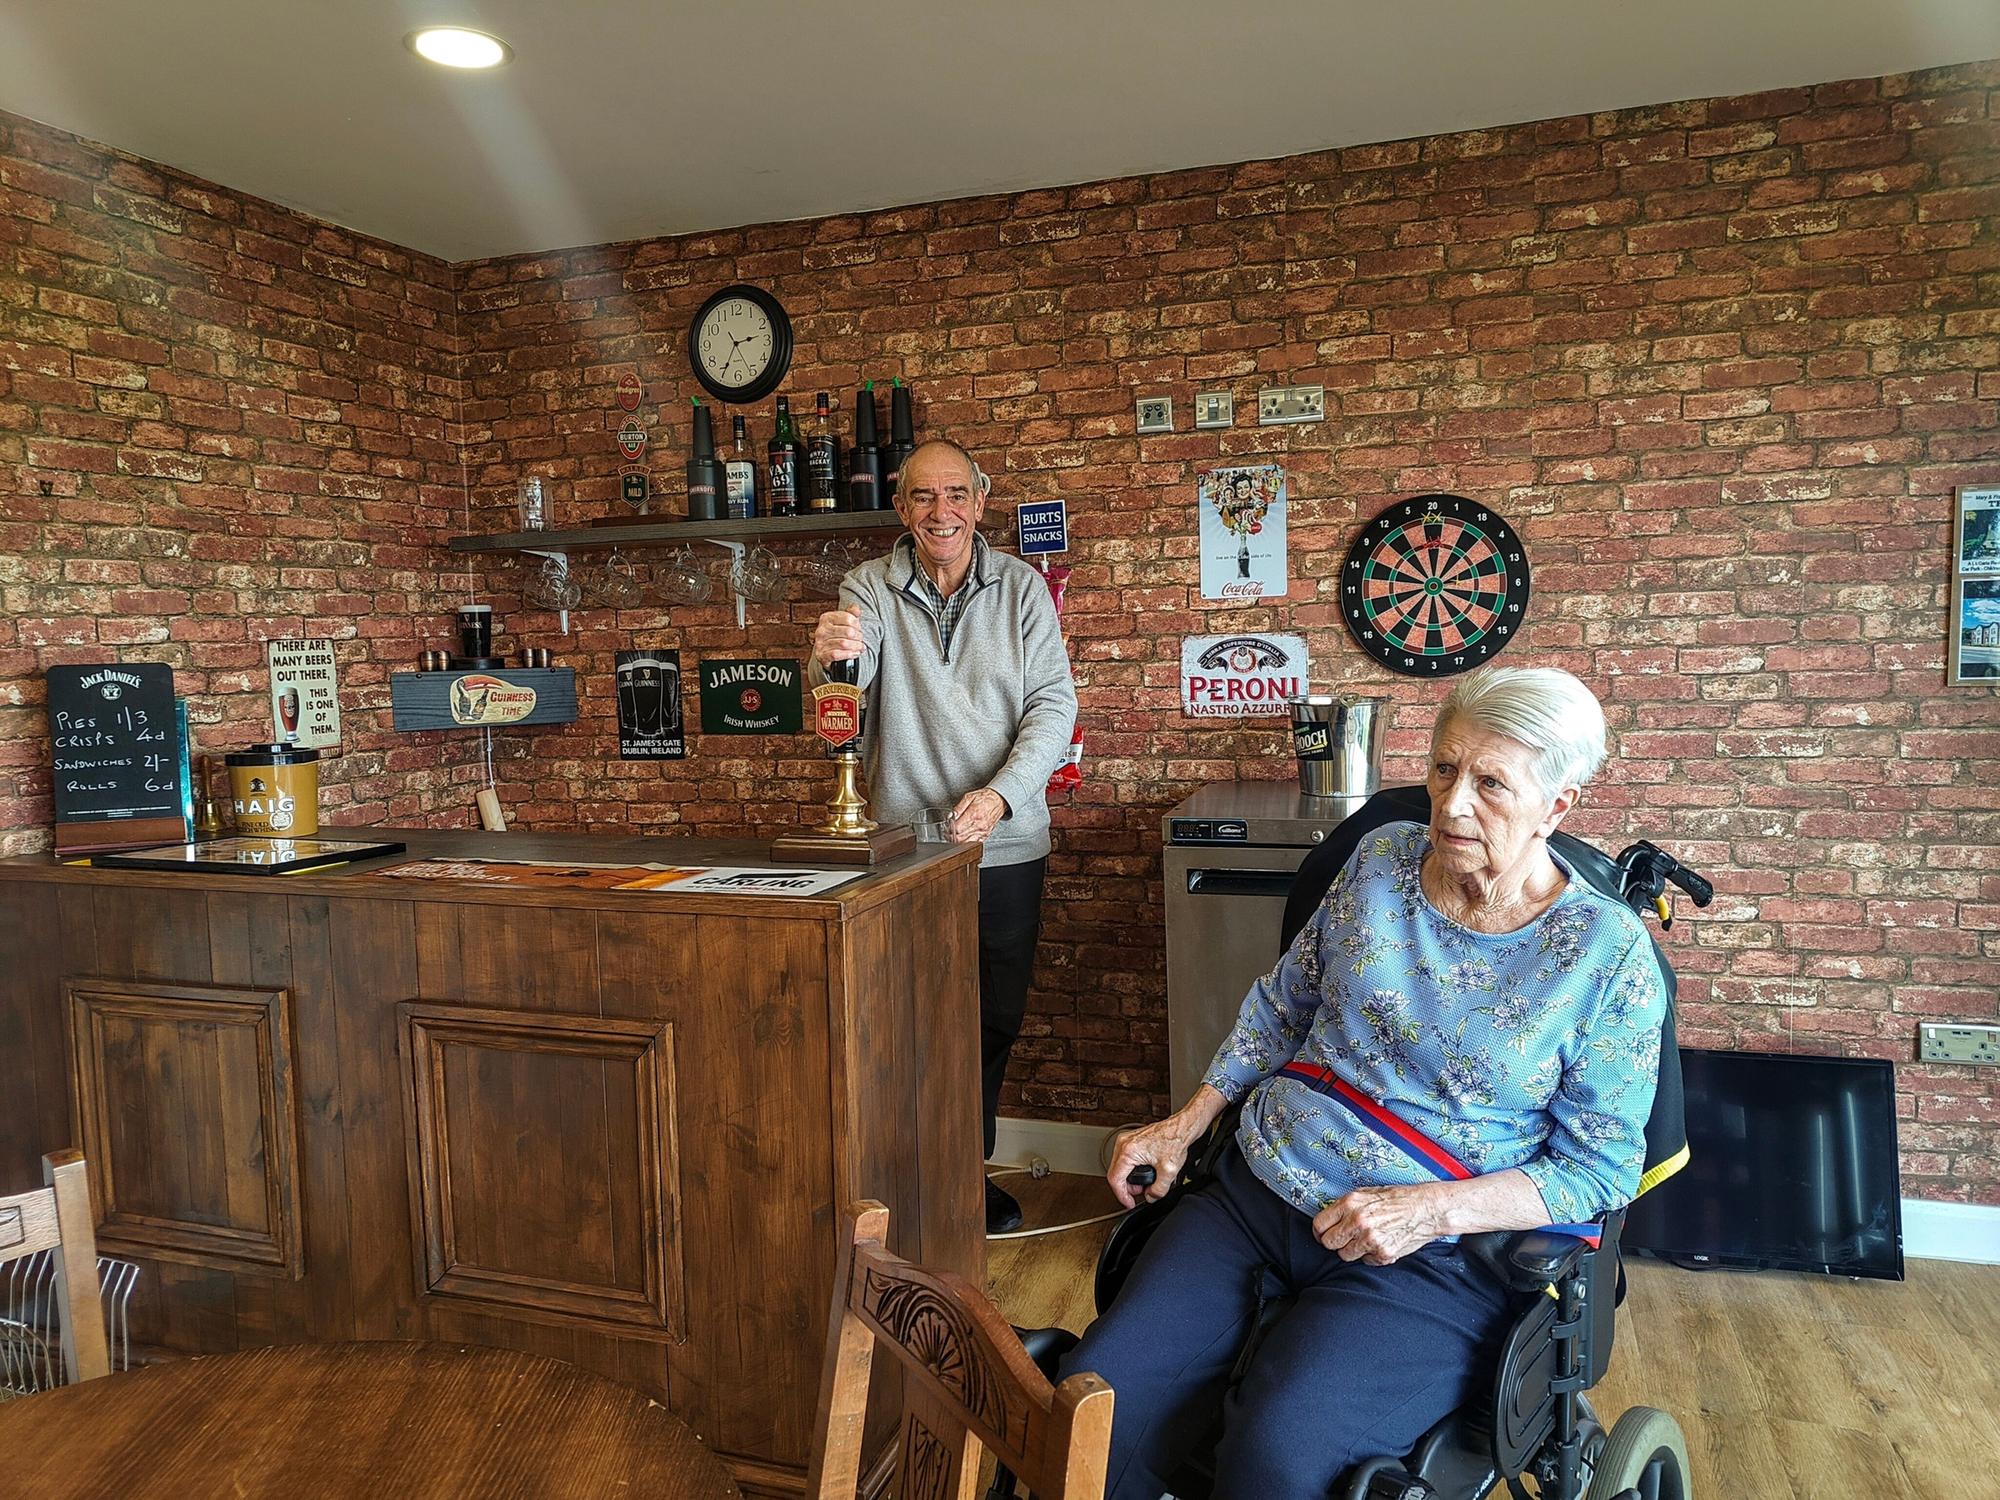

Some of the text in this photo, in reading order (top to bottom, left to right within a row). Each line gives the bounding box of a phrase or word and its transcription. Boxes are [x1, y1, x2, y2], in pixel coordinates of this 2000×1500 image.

[730, 304, 742, 316] 12
[750, 306, 752, 318] 1
[717, 310, 726, 322] 11
[759, 318, 766, 329] 2
[708, 324, 719, 336] 10
[703, 340, 711, 351] 9
[763, 334, 771, 346] 3
[708, 356, 716, 367] 8
[760, 352, 768, 363] 4
[734, 370, 742, 382] 6
[749, 365, 757, 376] 5
[769, 462, 794, 476] VAT
[727, 472, 749, 480] AMB'S
[628, 488, 642, 497] MILD
[1428, 502, 1438, 510] 20
[1022, 511, 1062, 526] BURTS
[1380, 520, 1389, 528] 12
[1023, 530, 1062, 543] SNACKS
[1499, 530, 1504, 538] 4
[1364, 538, 1370, 546] 9
[1516, 578, 1521, 586] 6
[1363, 631, 1373, 639] 16
[1497, 626, 1507, 634] 15
[277, 640, 326, 652] THERE ARE
[1384, 648, 1389, 656] 7
[273, 654, 332, 667] MANY BEERS
[80, 669, 142, 689] JACK DANIEL'S
[277, 669, 330, 681] OUT THERE,
[710, 664, 792, 688] JAMESON
[634, 680, 660, 688] GUINNESS
[1189, 676, 1299, 701] PERONI
[310, 688, 328, 697] THIS
[490, 692, 534, 703] GUINNESS
[306, 700, 334, 710] IS ONE
[1191, 703, 1290, 714] NASTRO AZZURR
[502, 706, 522, 716] TIME
[56, 706, 148, 731] PIES 1/3
[315, 713, 326, 722] OF
[724, 714, 779, 728] IRISH WHISKEY
[310, 724, 335, 734] THEM.
[821, 718, 853, 730] WARMER
[55, 728, 165, 748] CRISPS 4d
[1295, 728, 1328, 751] HOOCH
[54, 759, 132, 770] SANDWICHES
[66, 778, 174, 792] ROLLS 6d
[234, 798, 294, 813] HAIG
[692, 877, 815, 888] CARLING
